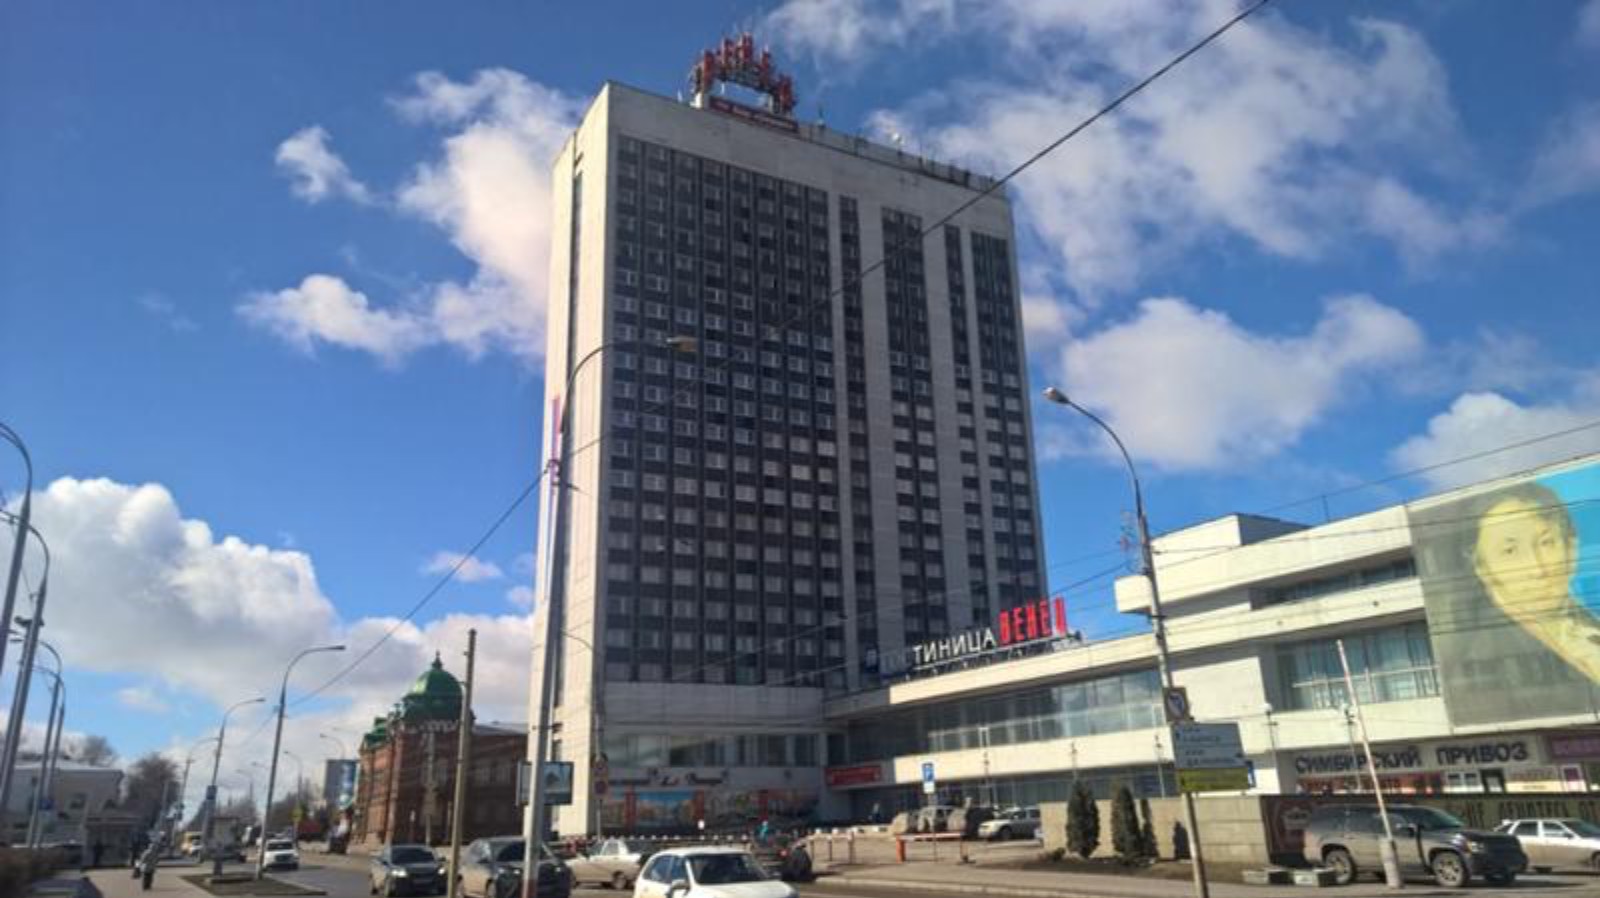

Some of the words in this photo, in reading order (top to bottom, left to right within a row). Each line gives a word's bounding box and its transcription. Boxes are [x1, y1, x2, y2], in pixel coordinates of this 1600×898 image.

[869, 627, 998, 671] ТИНИЦА
[1296, 746, 1422, 773] СИМБИРСКИЙ
[1437, 742, 1528, 766] ПРИВОЗ
